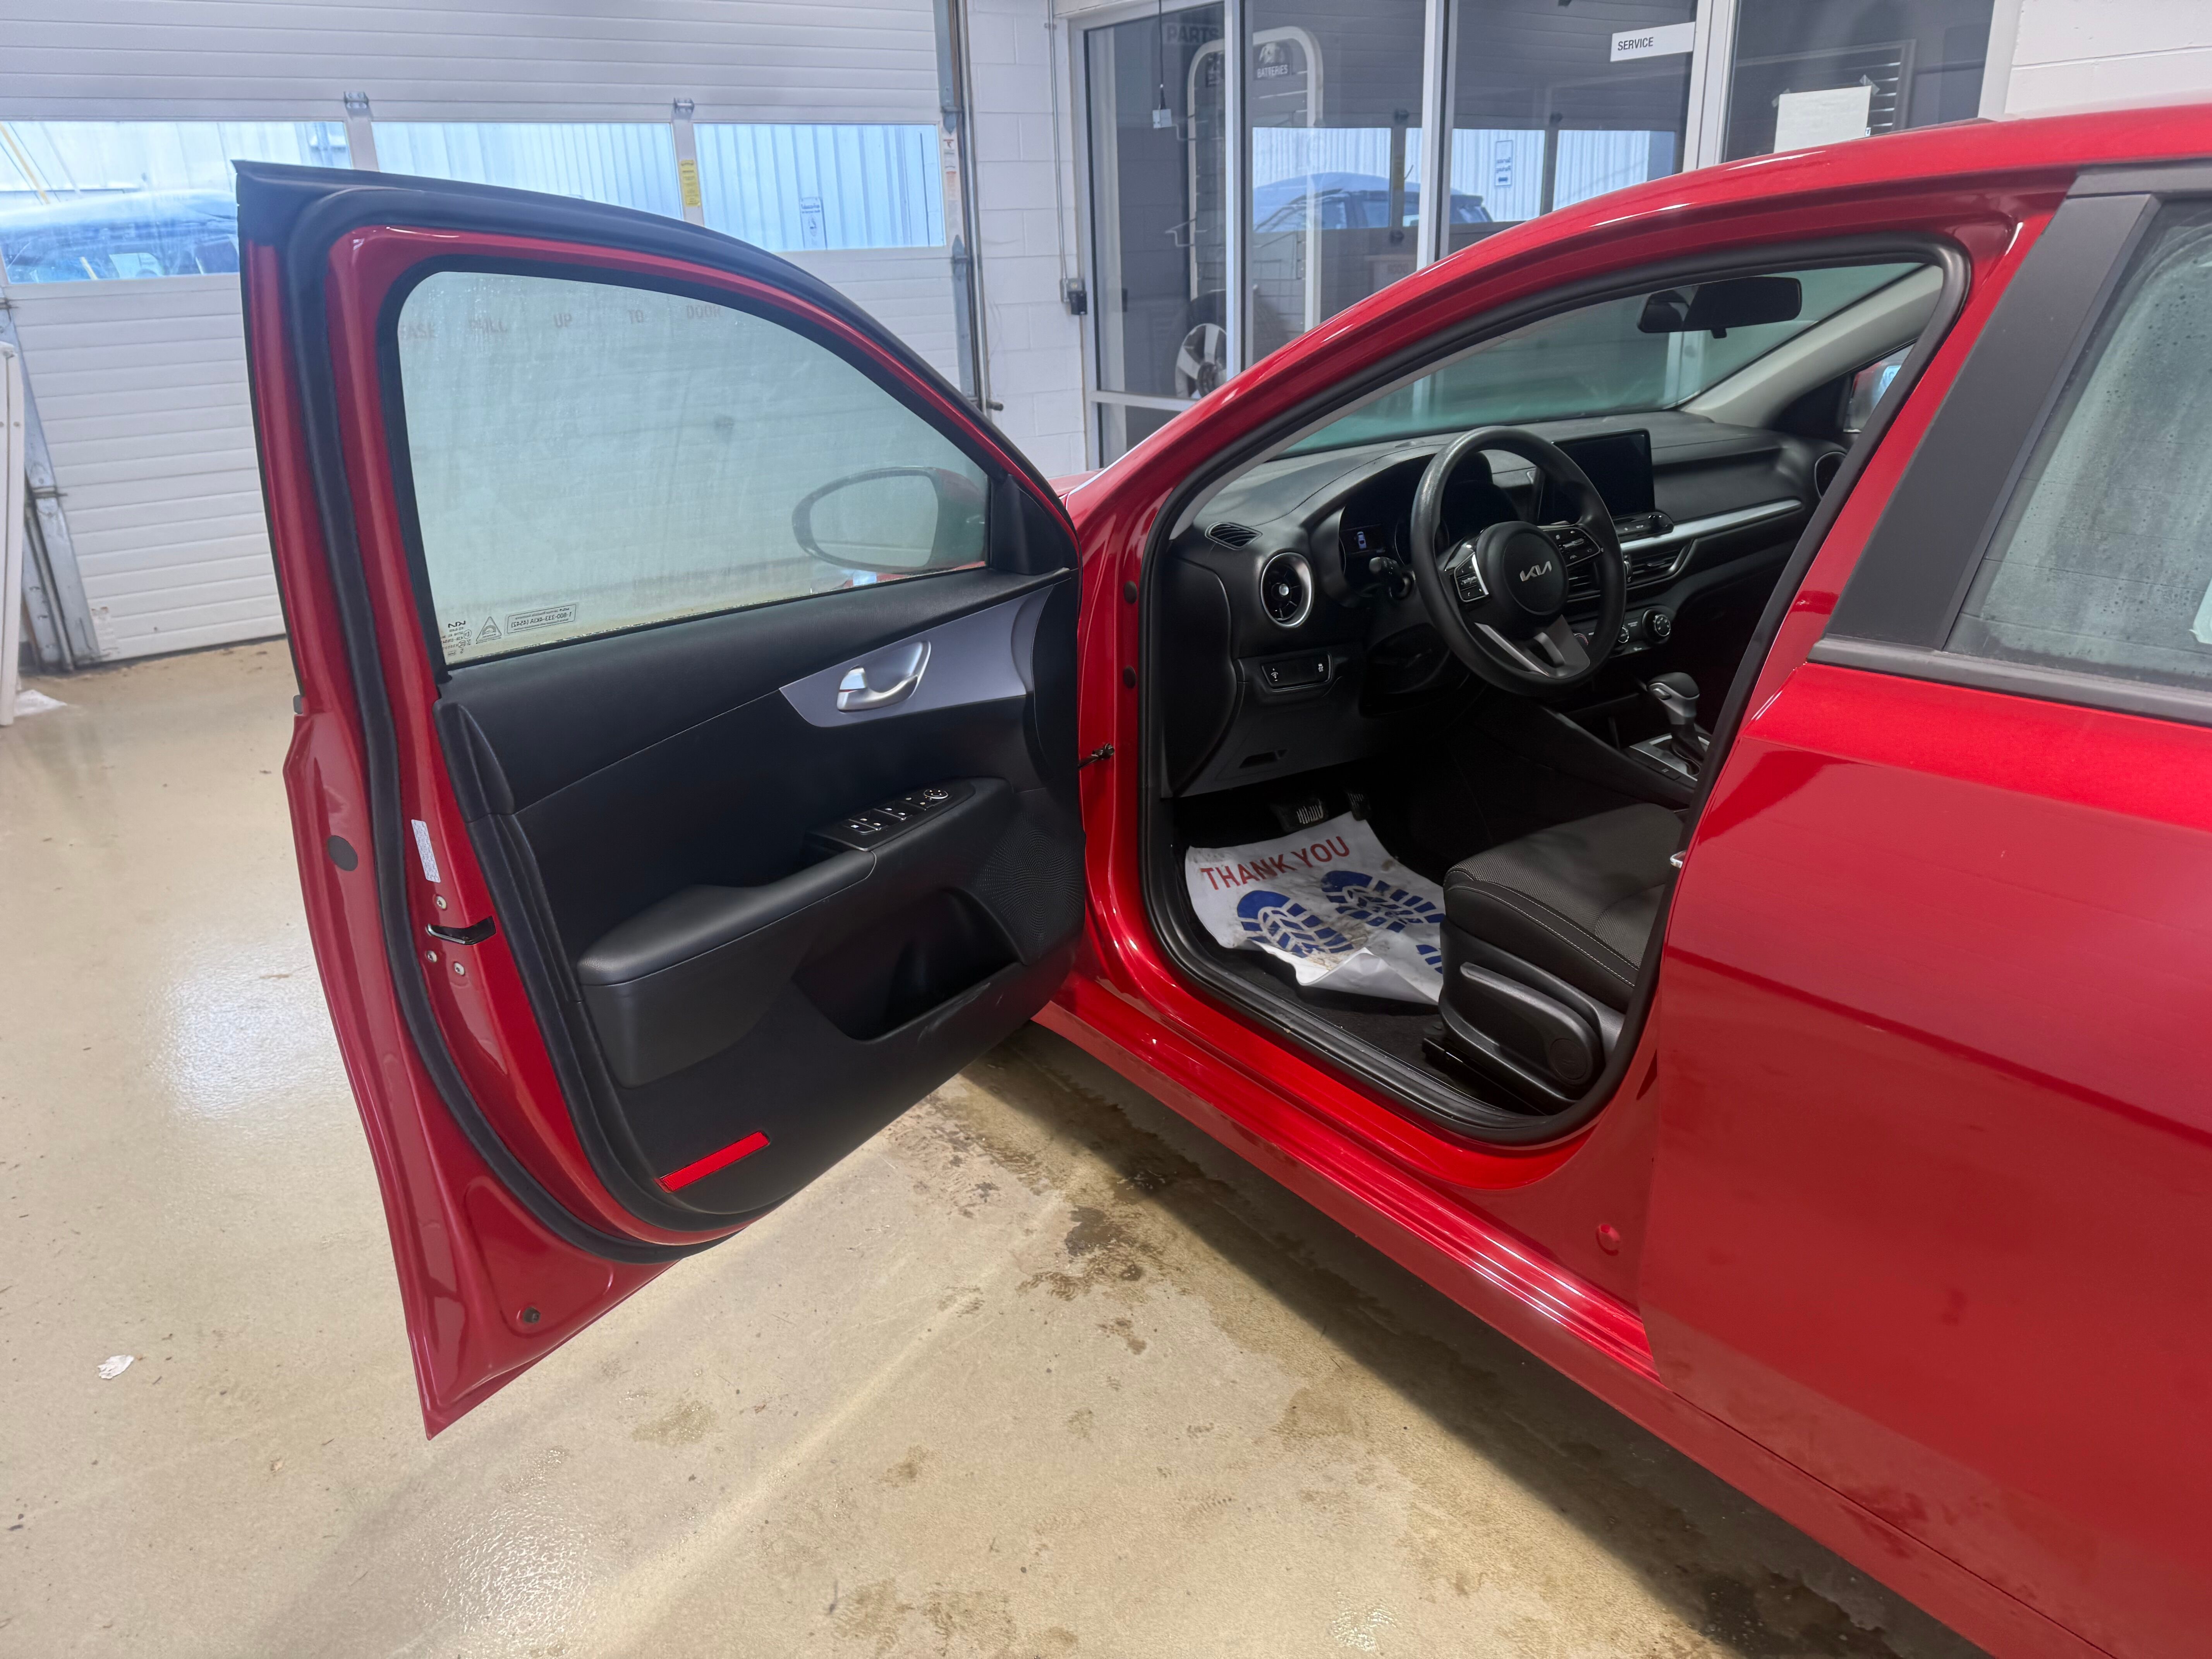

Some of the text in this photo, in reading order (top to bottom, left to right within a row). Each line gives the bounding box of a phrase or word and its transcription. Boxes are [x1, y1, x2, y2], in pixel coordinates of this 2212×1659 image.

[1167, 25, 1219, 43] PARTS
[1618, 37, 1654, 51] SERVICE
[1257, 64, 1288, 78] BATTERIES
[553, 312, 573, 328] UP
[627, 309, 644, 324] TO
[686, 304, 721, 319] DOOR
[1520, 561, 1552, 582] KIA
[1200, 836, 1350, 890] THANK YOU
